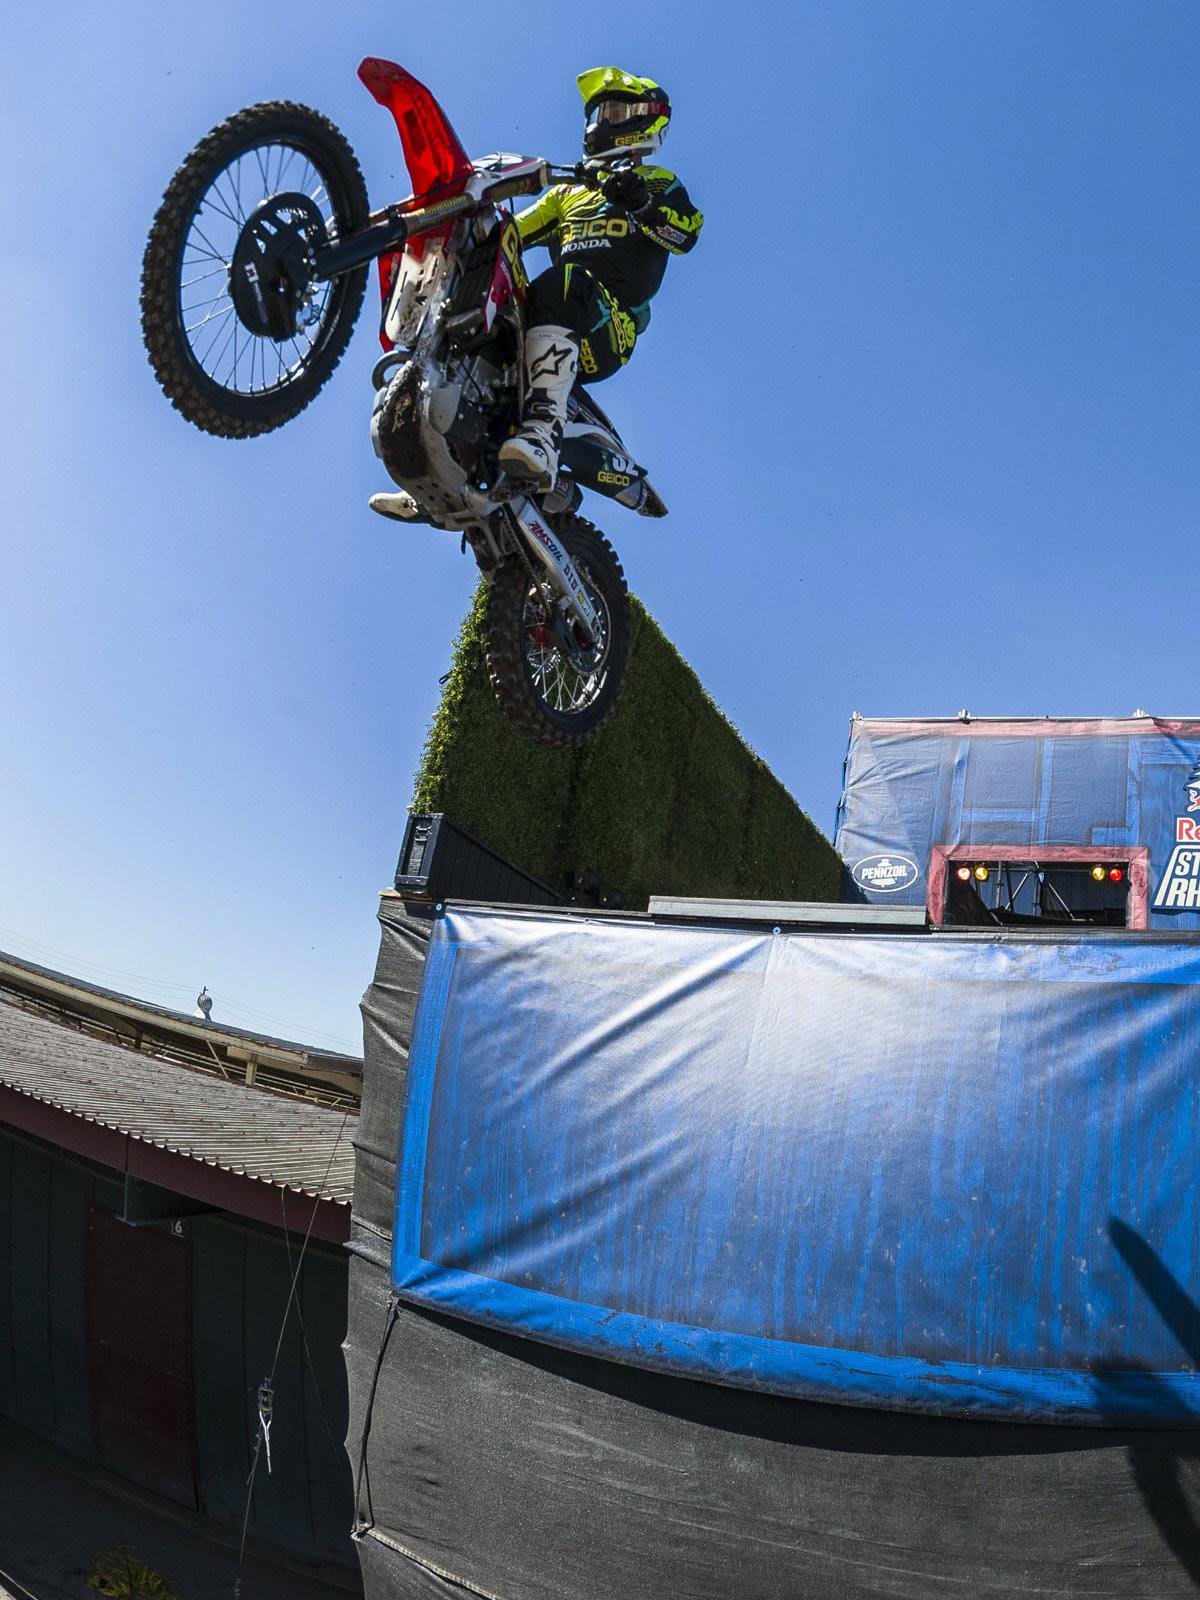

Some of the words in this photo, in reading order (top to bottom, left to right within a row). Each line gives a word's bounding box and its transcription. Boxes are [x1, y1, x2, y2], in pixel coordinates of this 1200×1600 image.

[614, 133, 654, 147] GEICO
[561, 239, 612, 255] HONDA
[597, 470, 630, 486] GEICO
[861, 865, 908, 880] PENNZOIL
